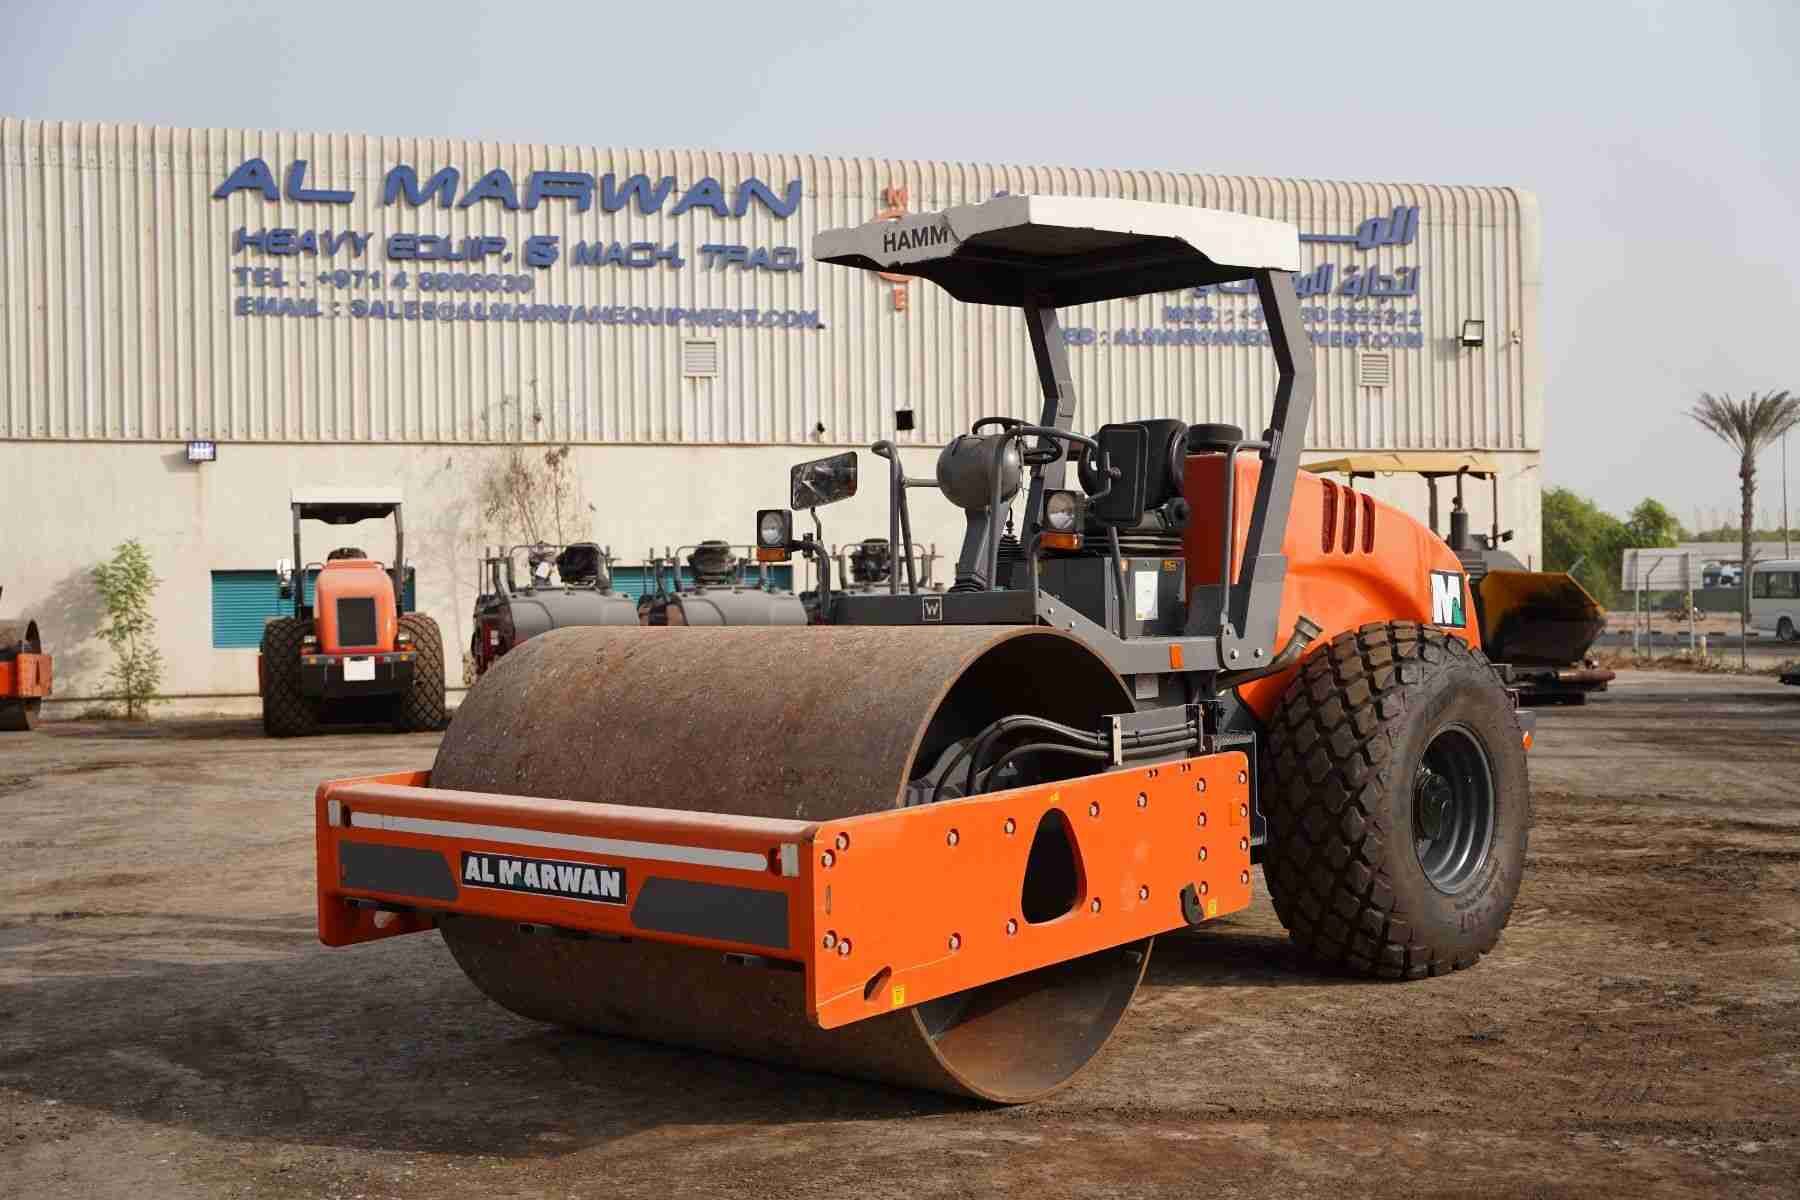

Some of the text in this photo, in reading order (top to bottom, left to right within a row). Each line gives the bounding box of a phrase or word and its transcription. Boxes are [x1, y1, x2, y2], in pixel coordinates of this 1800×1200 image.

[213, 158, 802, 218] AL MARWAN
[234, 227, 373, 255] HEAVY
[883, 225, 949, 253] HAMM
[465, 855, 621, 897] AL MARWAN
